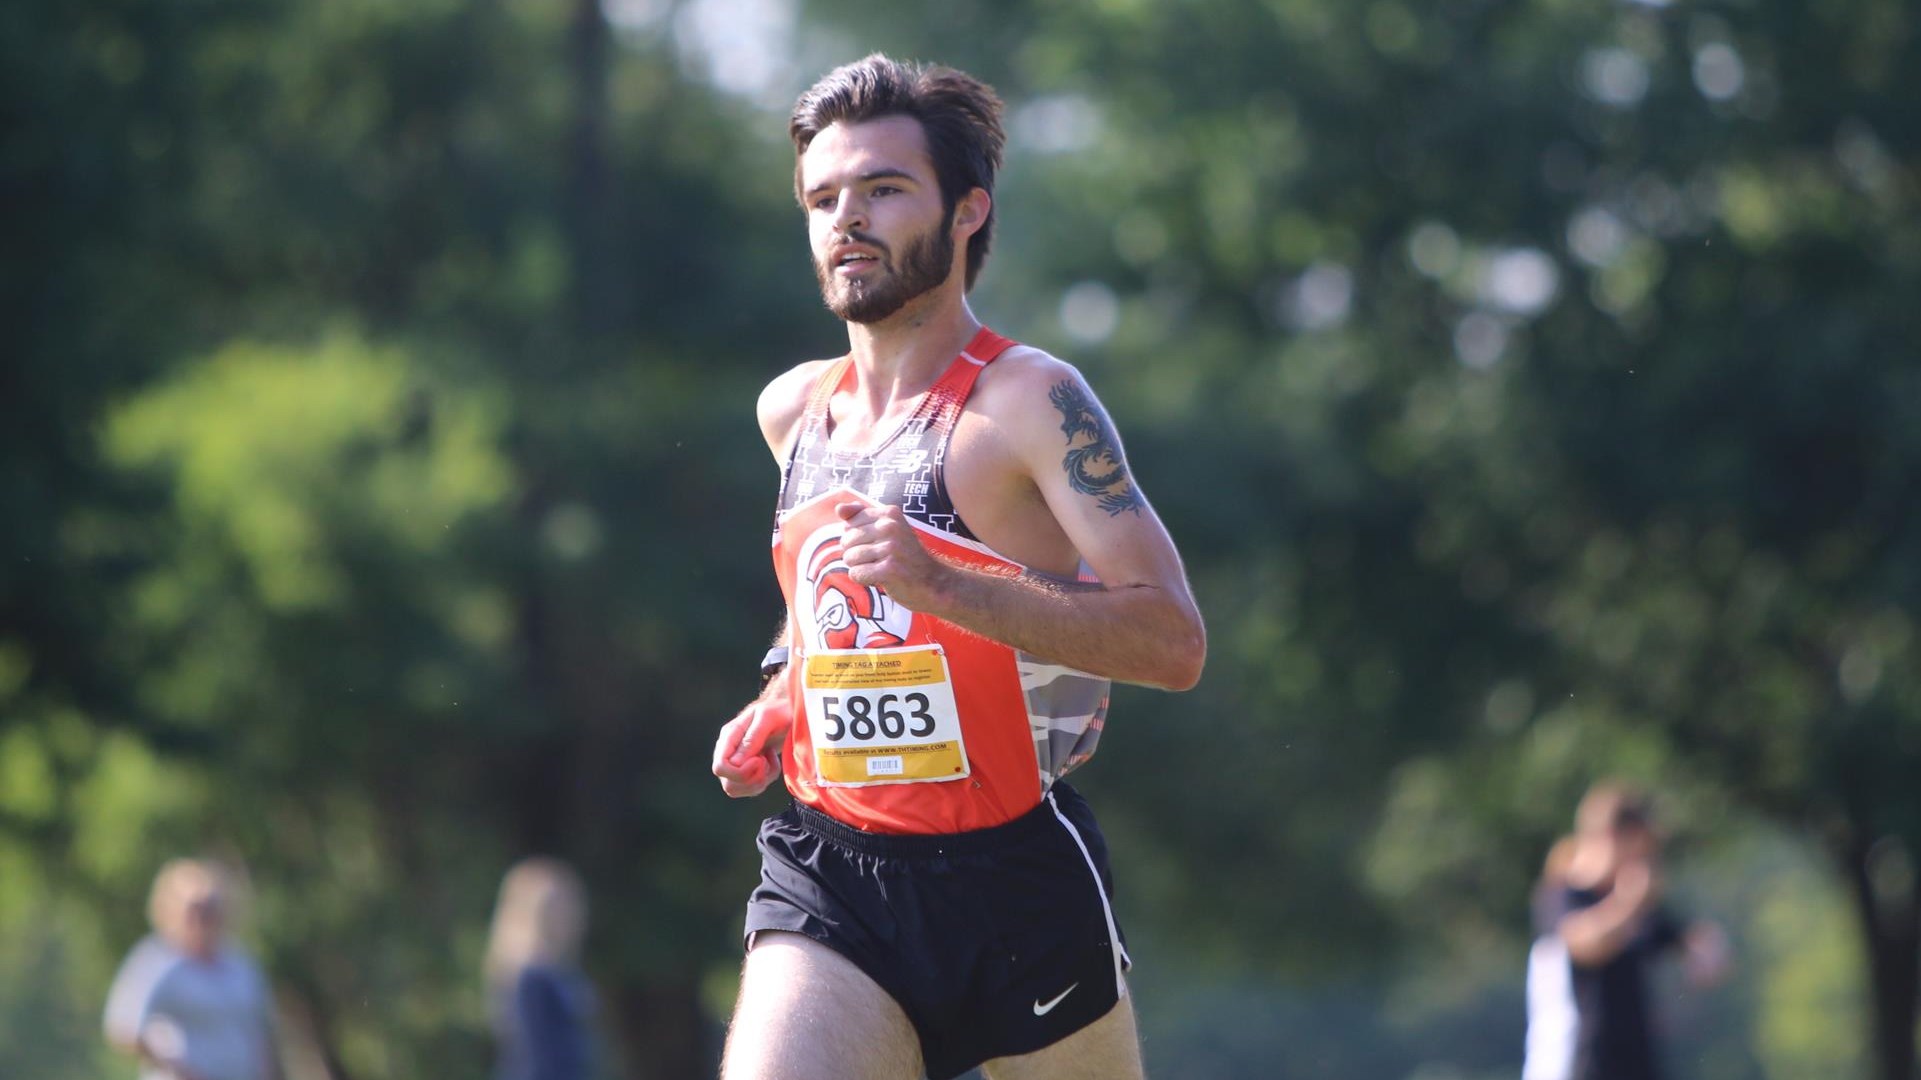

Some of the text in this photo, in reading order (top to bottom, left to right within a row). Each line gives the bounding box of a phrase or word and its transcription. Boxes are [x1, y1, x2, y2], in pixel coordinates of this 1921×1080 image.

[904, 483, 929, 495] TECH
[868, 659, 902, 669] ATACHED
[823, 692, 936, 742] 5863
